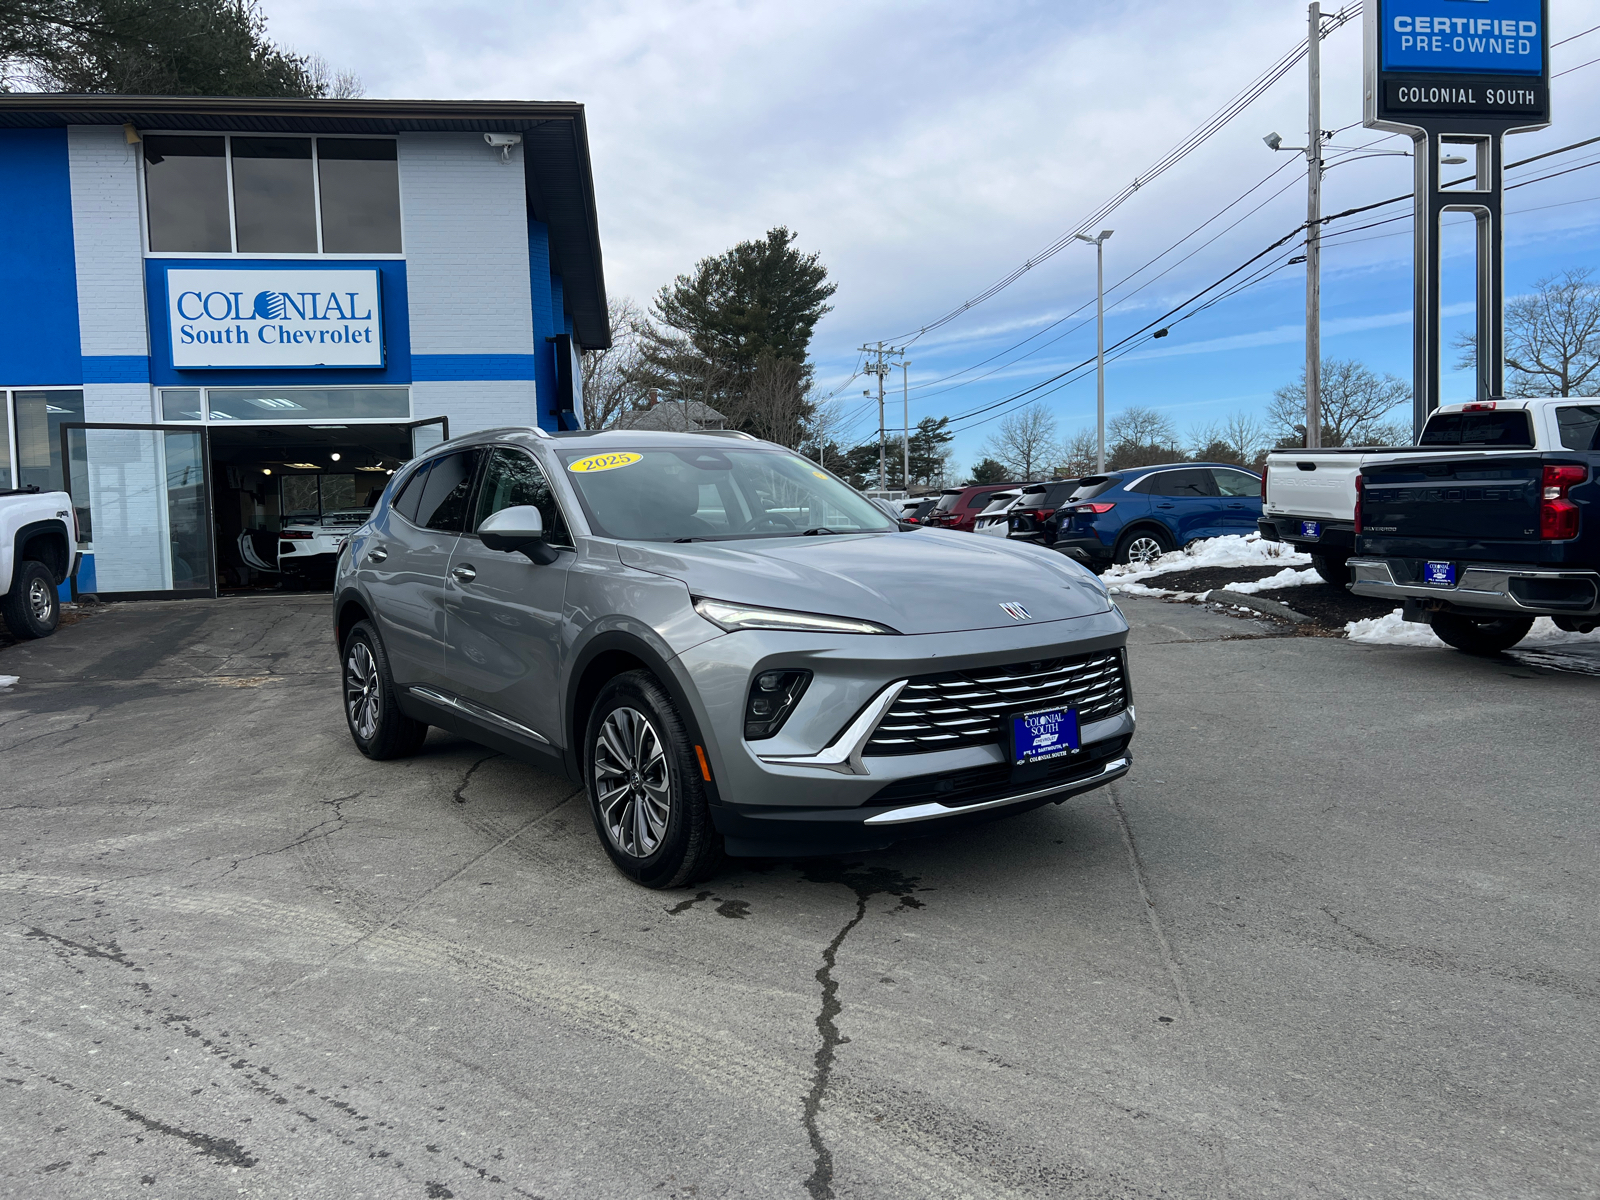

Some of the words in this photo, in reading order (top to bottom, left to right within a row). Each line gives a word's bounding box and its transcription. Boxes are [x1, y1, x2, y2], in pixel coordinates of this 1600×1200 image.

[1394, 16, 1537, 37] CERTIFIED
[1402, 35, 1530, 55] PRE-OWNED
[1399, 87, 1476, 104] COLONIAL
[1486, 89, 1535, 105] SOUTH
[177, 290, 372, 321] COLONIAL
[180, 324, 250, 344] South
[258, 324, 373, 344] Chevrolet
[583, 453, 631, 471] 2025
[1272, 477, 1345, 488] CHEVROLET
[1366, 489, 1521, 502] CHEVROLET
[1025, 713, 1064, 728] COLONIAL
[1031, 722, 1059, 736] SOUTH
[1030, 754, 1051, 762] COLONIAL
